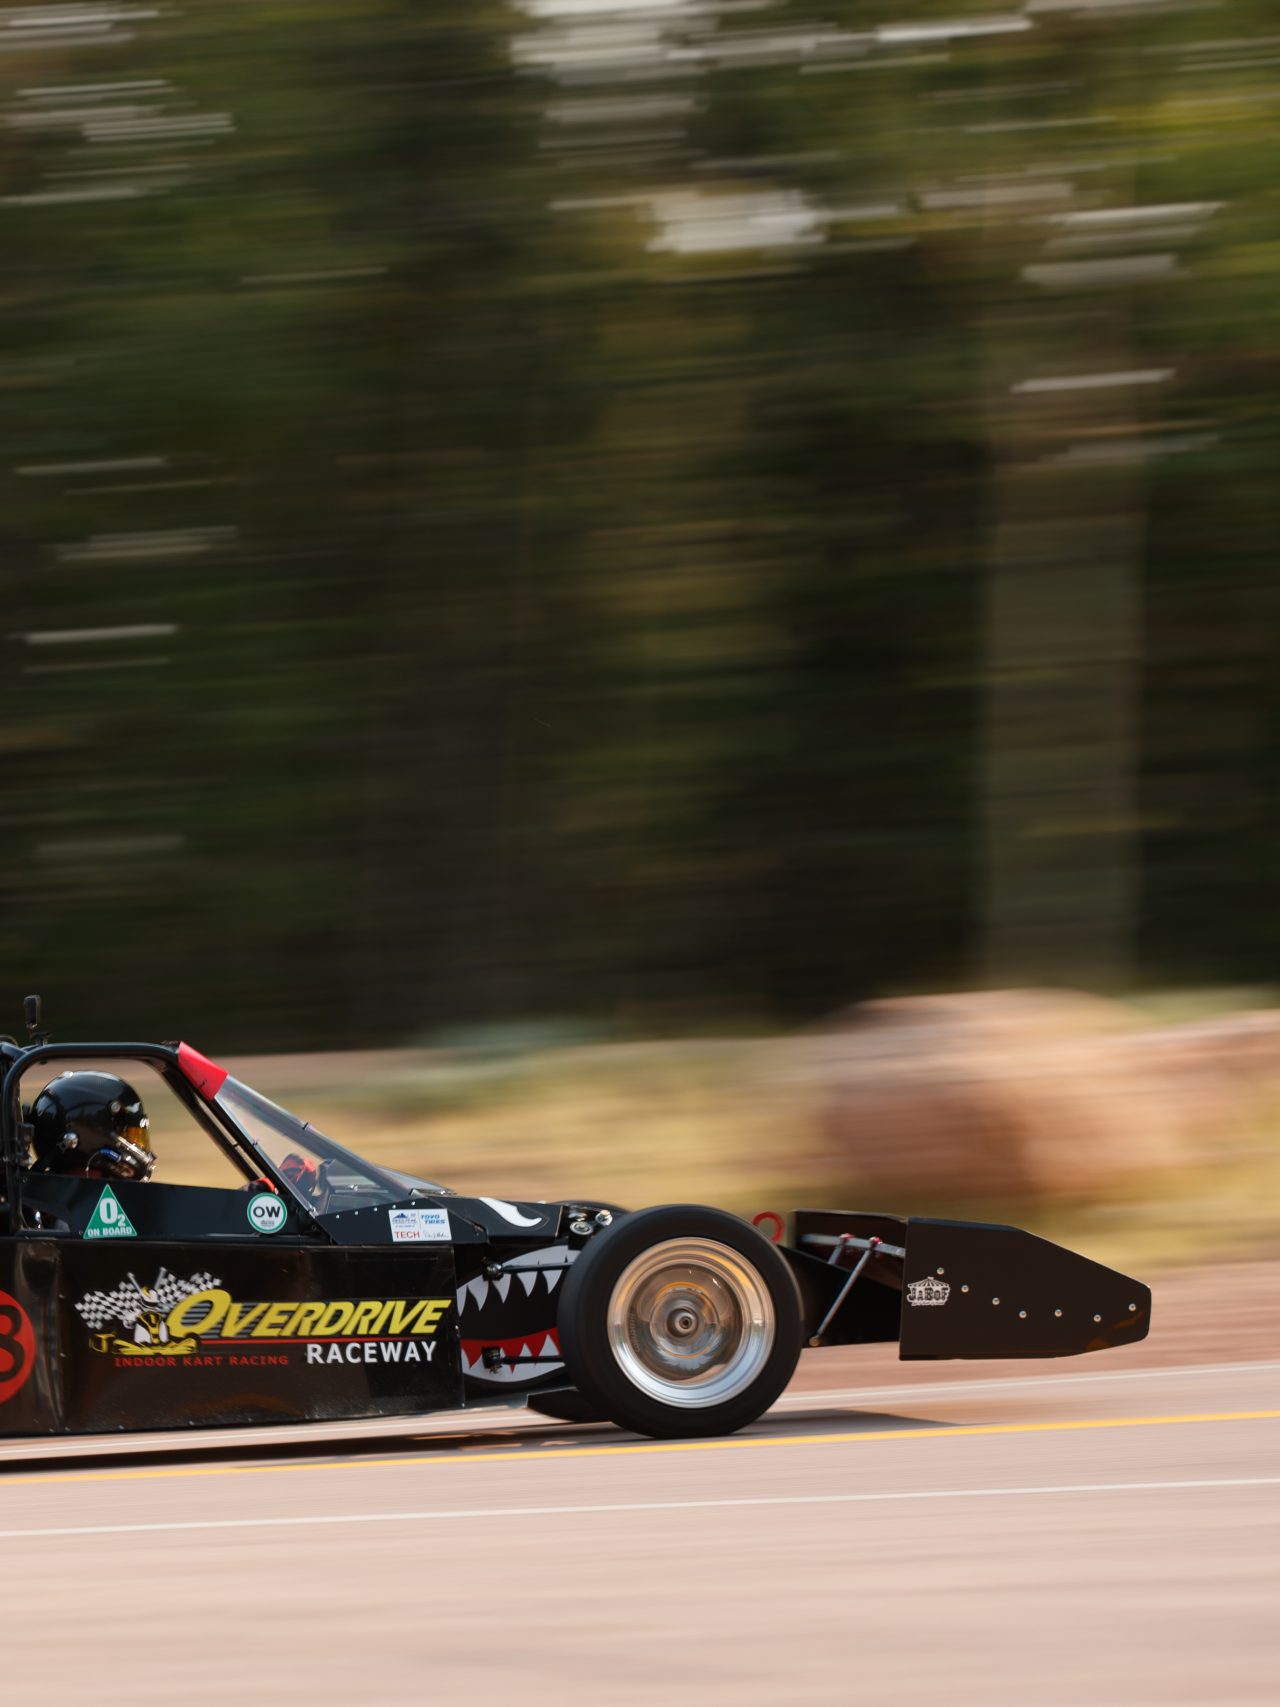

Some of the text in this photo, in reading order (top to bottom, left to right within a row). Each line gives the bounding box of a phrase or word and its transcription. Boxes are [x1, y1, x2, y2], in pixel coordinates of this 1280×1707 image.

[253, 1206, 281, 1218] OW
[87, 1226, 133, 1237] ON BOARD
[394, 1231, 420, 1239] TECH
[165, 1289, 453, 1338] OVERDRIVE
[305, 1340, 438, 1365] RACEWAY
[114, 1354, 290, 1368] INDOOR KART RACING
